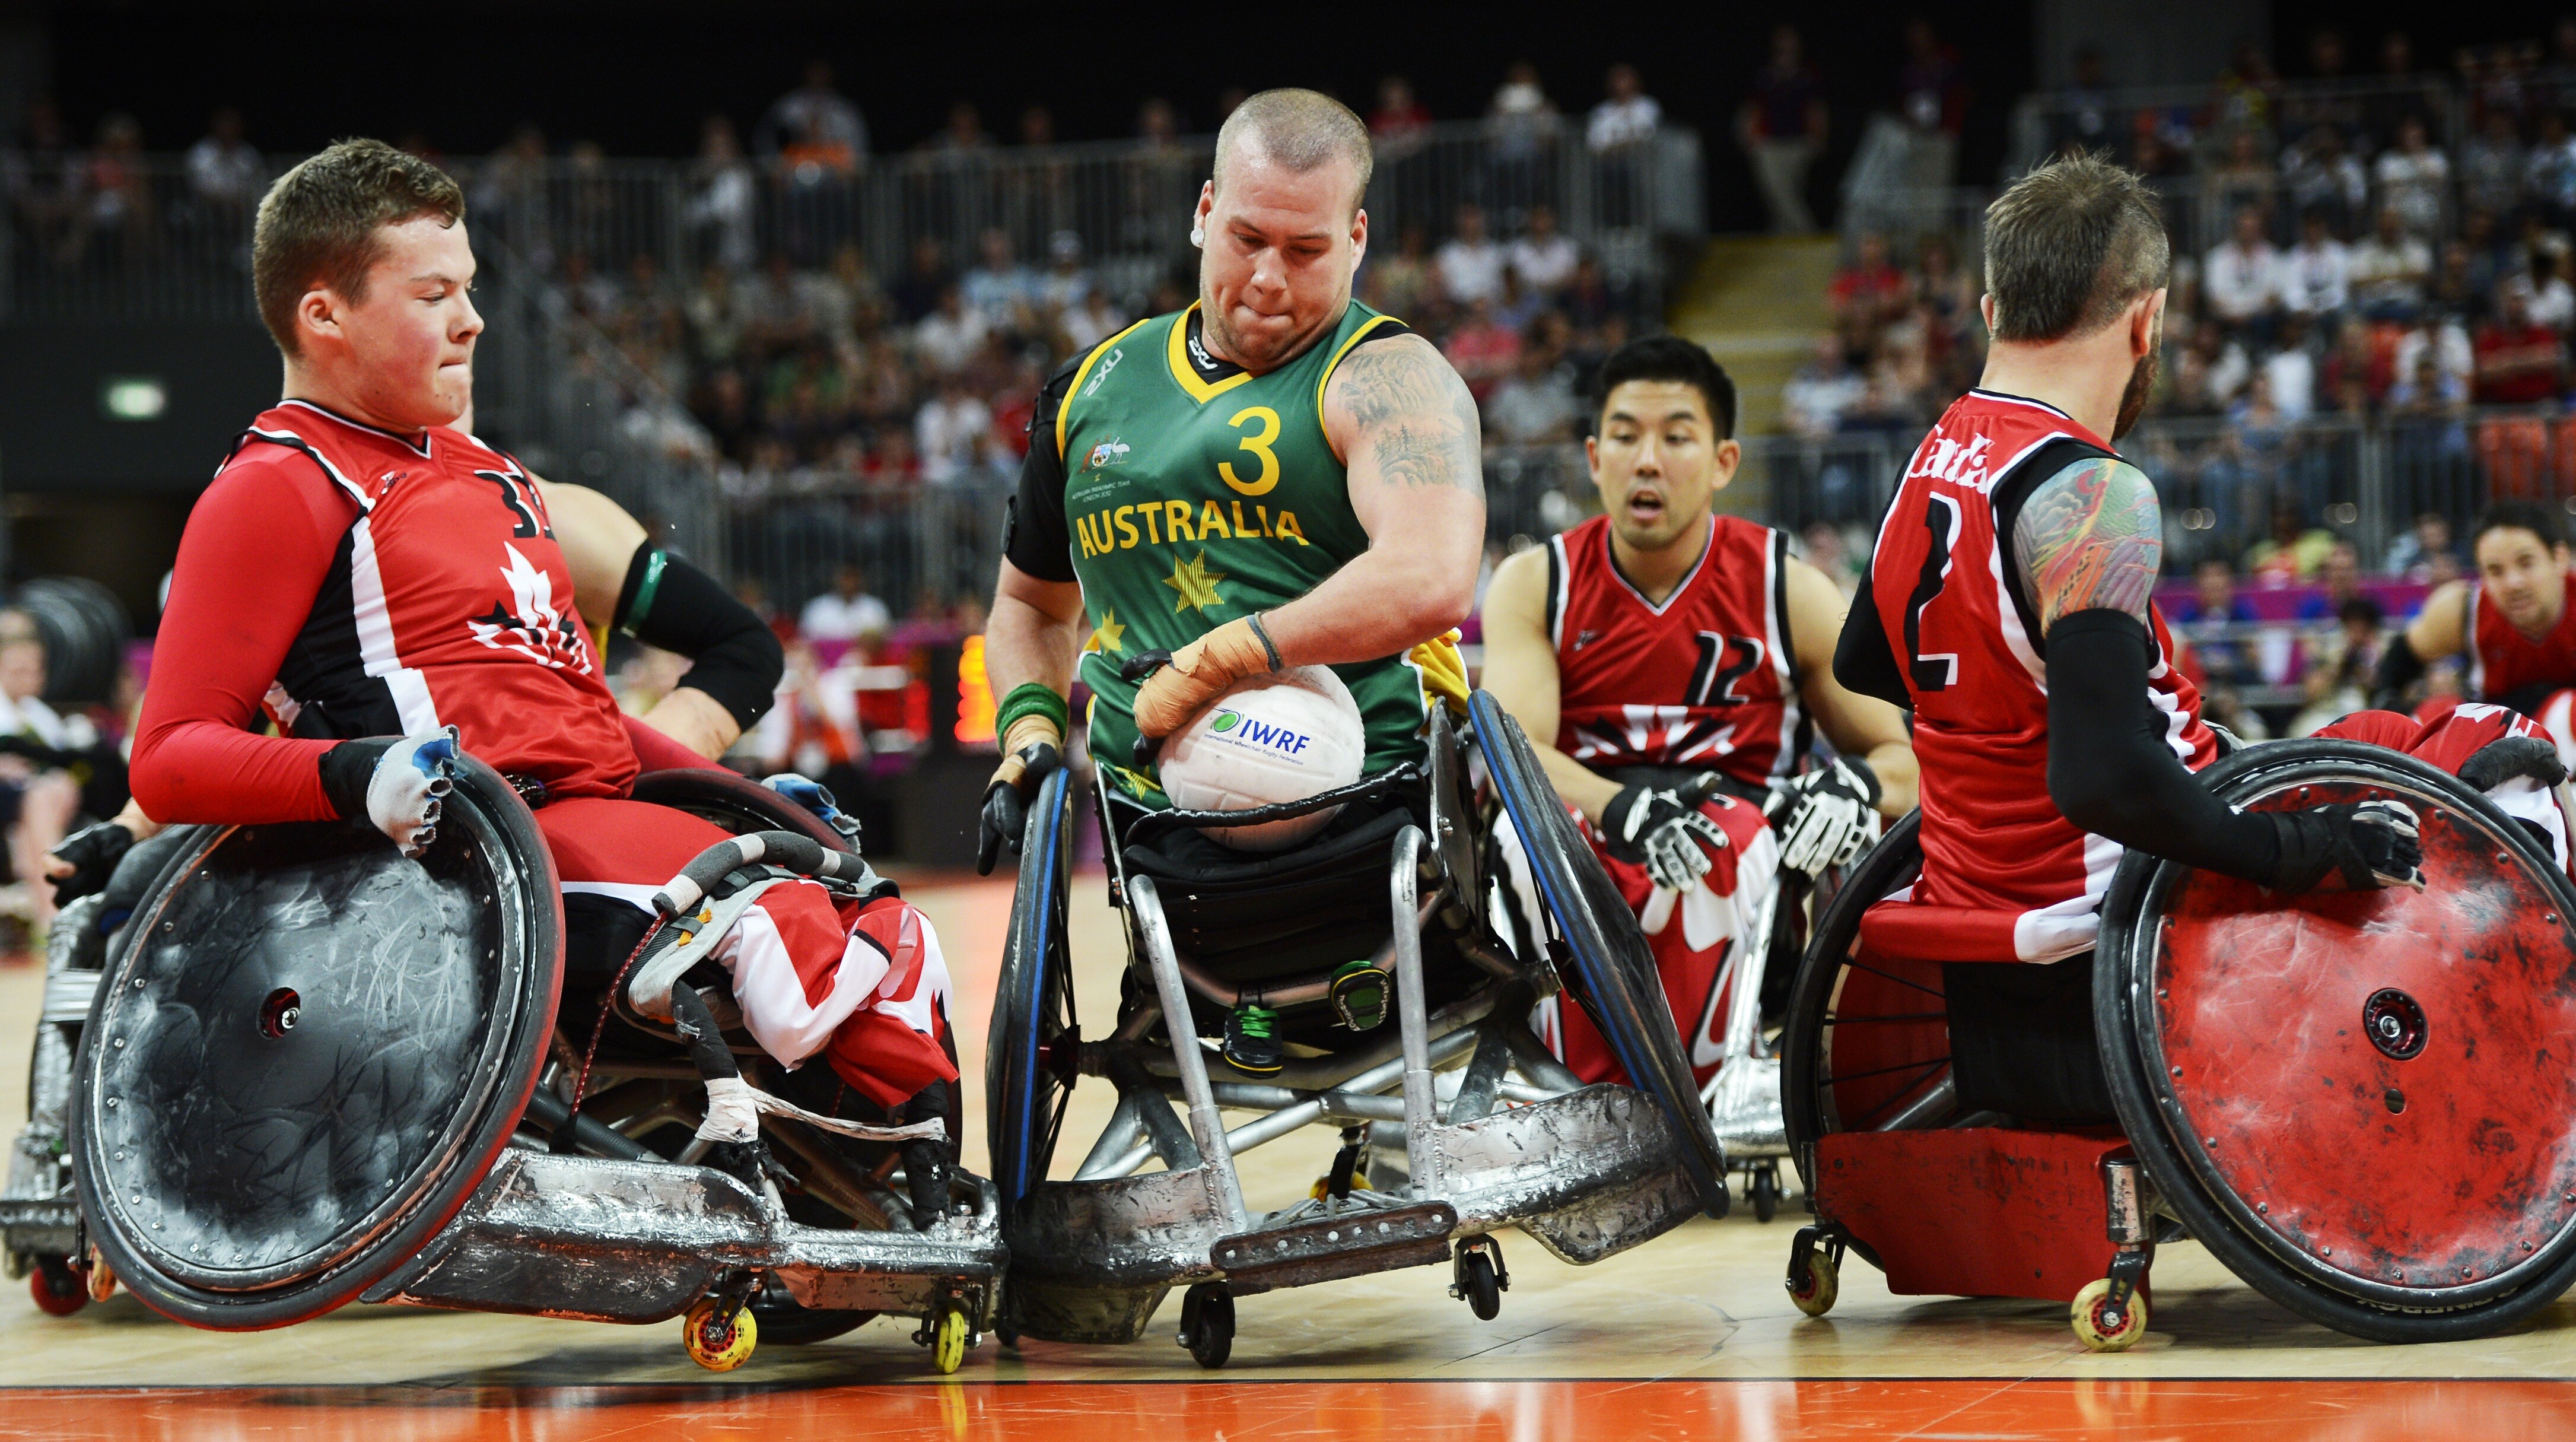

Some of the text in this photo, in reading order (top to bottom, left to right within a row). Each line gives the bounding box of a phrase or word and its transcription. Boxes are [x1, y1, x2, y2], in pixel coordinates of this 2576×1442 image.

[1083, 348, 1124, 397] 2XU
[1188, 335, 1218, 370] 2XU
[1217, 406, 1281, 496] 3
[1076, 500, 1310, 559] AUSTRALIA
[1903, 491, 1963, 692] 2
[1683, 630, 1765, 706] 12
[1204, 733, 1304, 766] International Wheelchair Rugby Federation
[1239, 719, 1311, 754] IWRF
